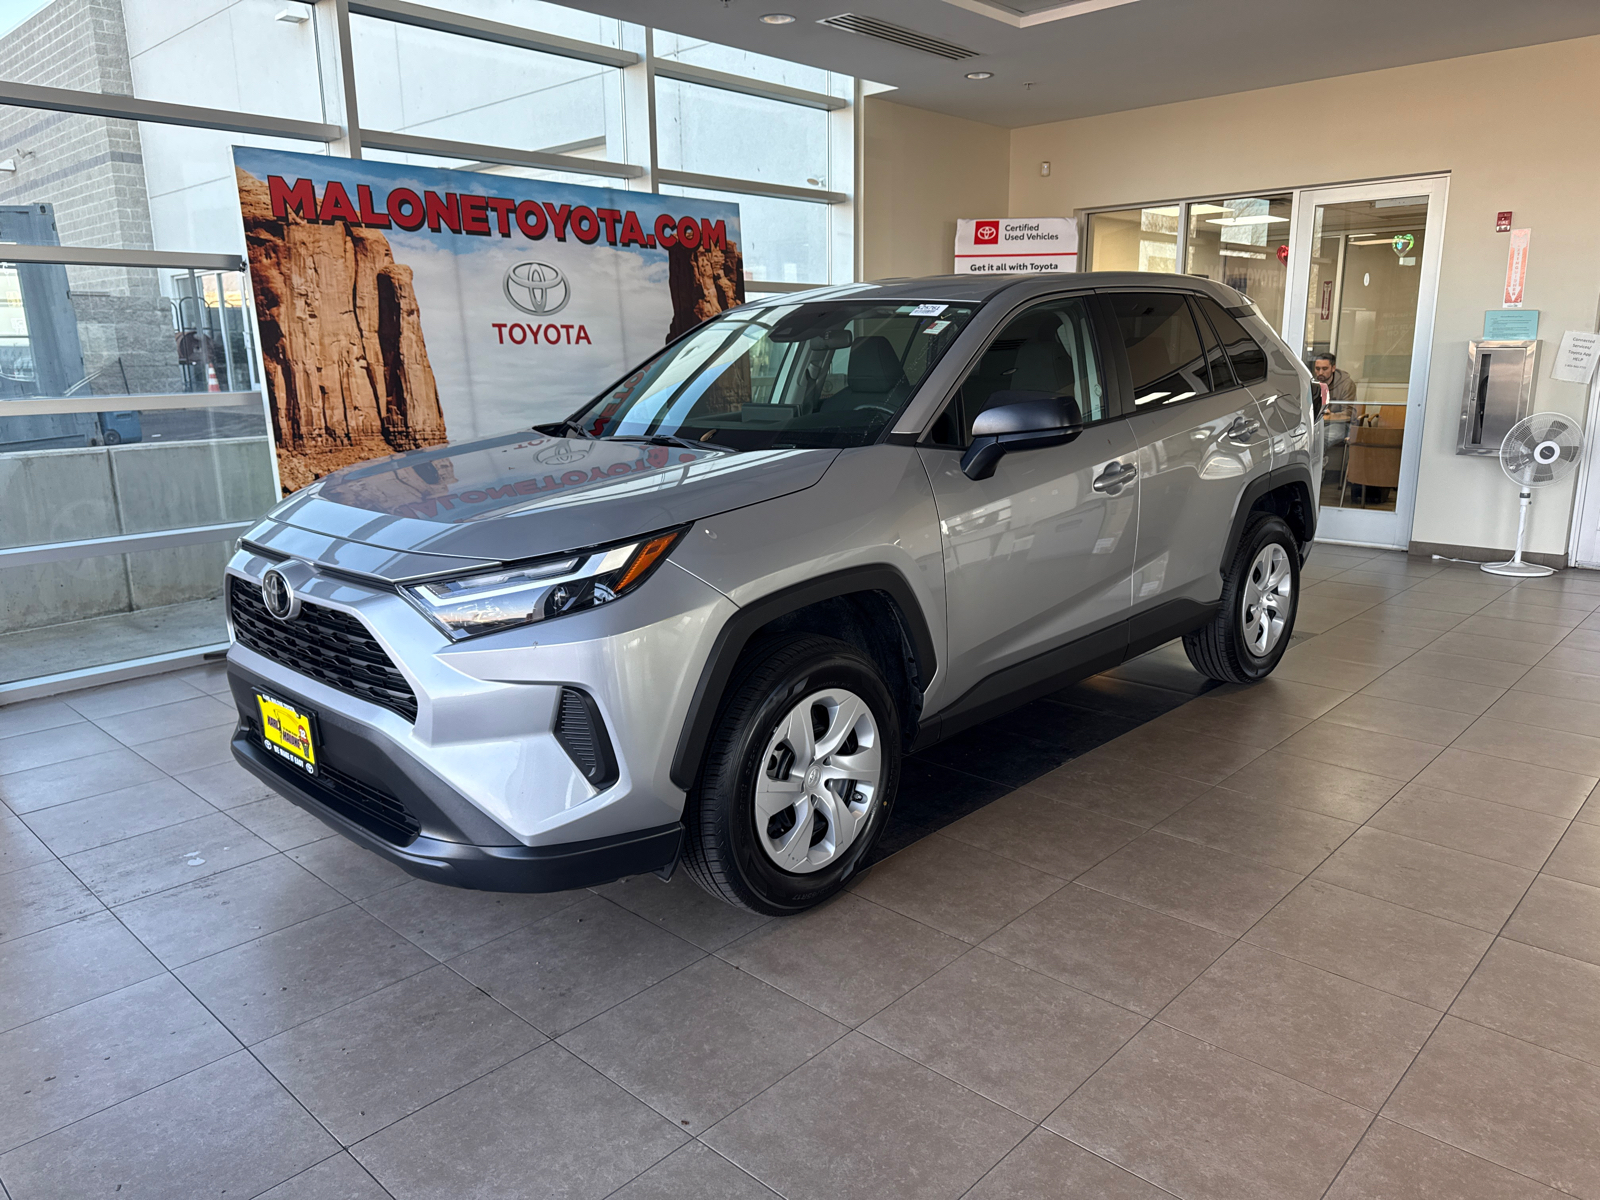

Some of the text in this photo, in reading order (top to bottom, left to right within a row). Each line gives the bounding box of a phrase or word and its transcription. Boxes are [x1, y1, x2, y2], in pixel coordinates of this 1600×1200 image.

[266, 174, 728, 252] MALONETOYOTA.COM
[1004, 223, 1040, 232] Certified
[1004, 232, 1059, 241] Used Vehicles
[970, 262, 1059, 272] Get it all with Toyota
[491, 322, 592, 346] TOYOTA
[1572, 336, 1596, 344] Connected
